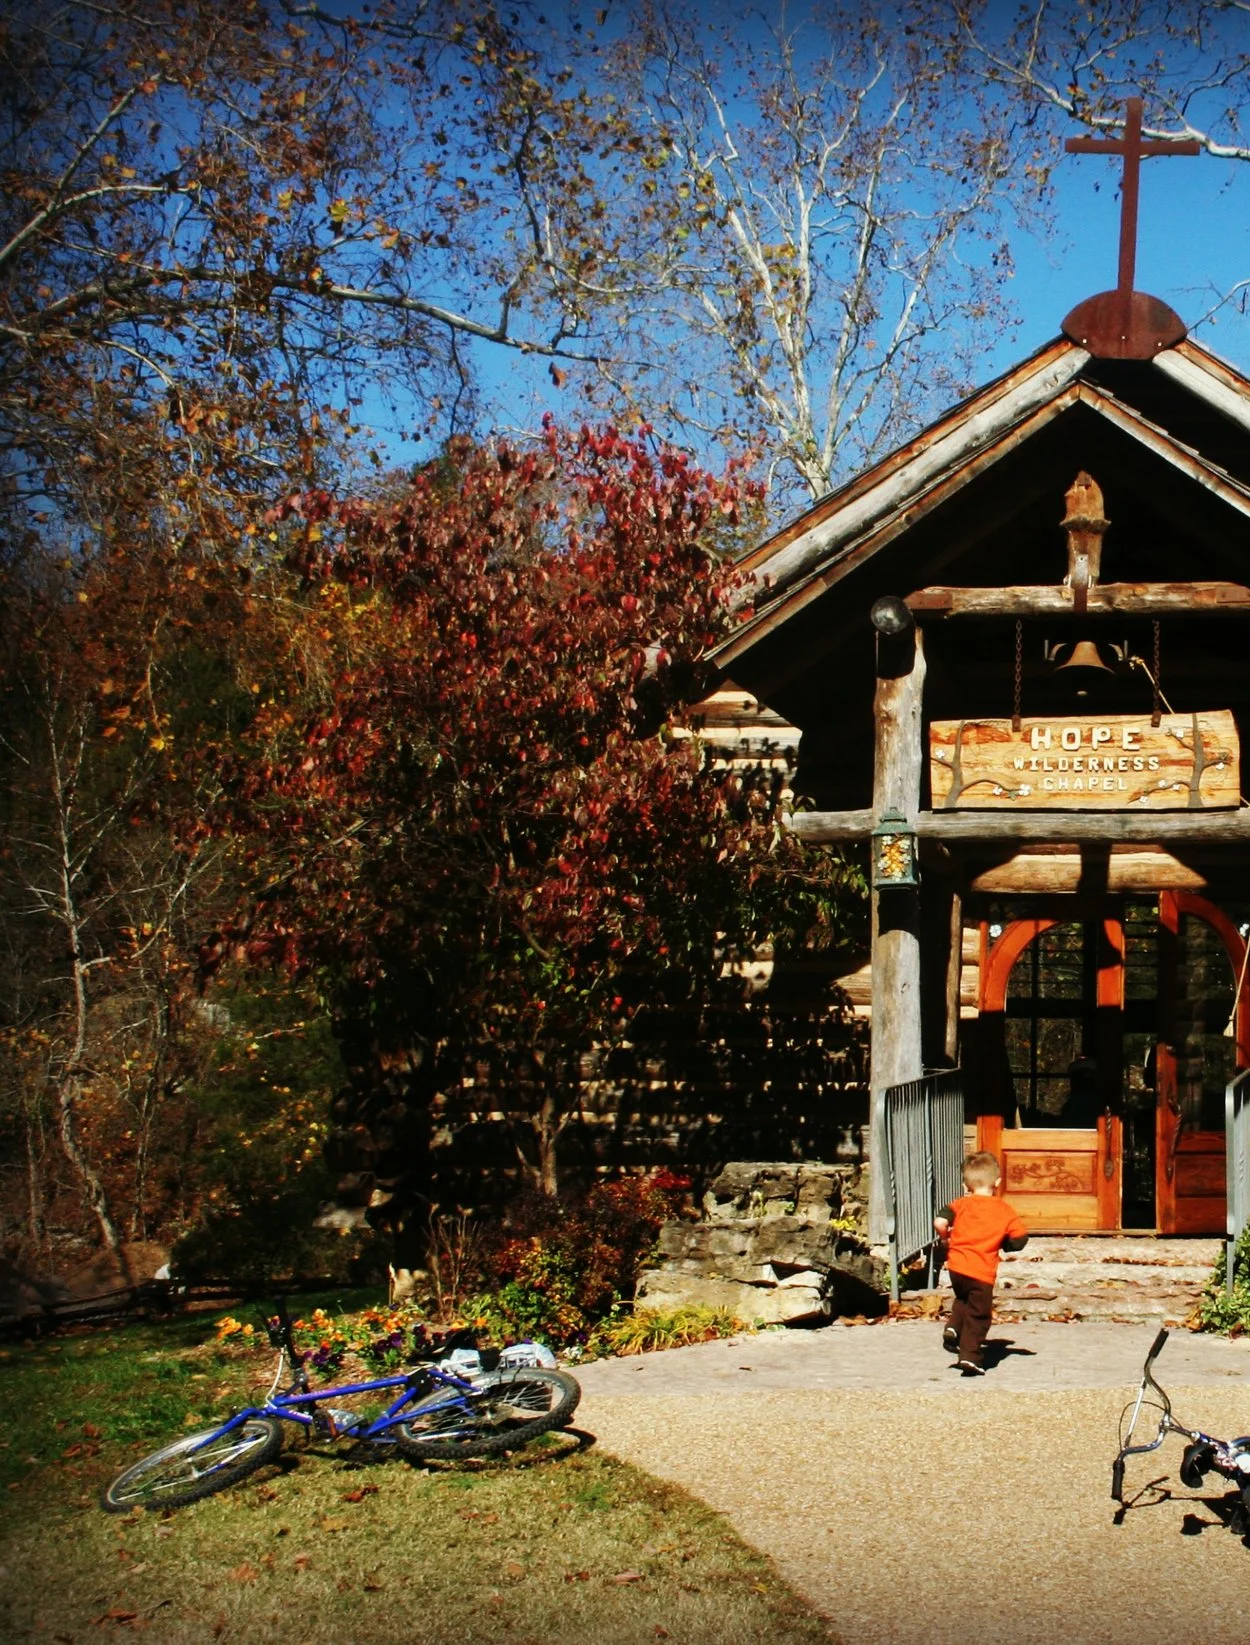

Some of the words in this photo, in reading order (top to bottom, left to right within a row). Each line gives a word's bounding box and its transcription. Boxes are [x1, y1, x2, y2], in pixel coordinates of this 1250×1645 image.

[1031, 727, 1142, 751] HOPE
[1013, 756, 1160, 772] WILDERNESS
[1043, 777, 1129, 792] CHAPEL
